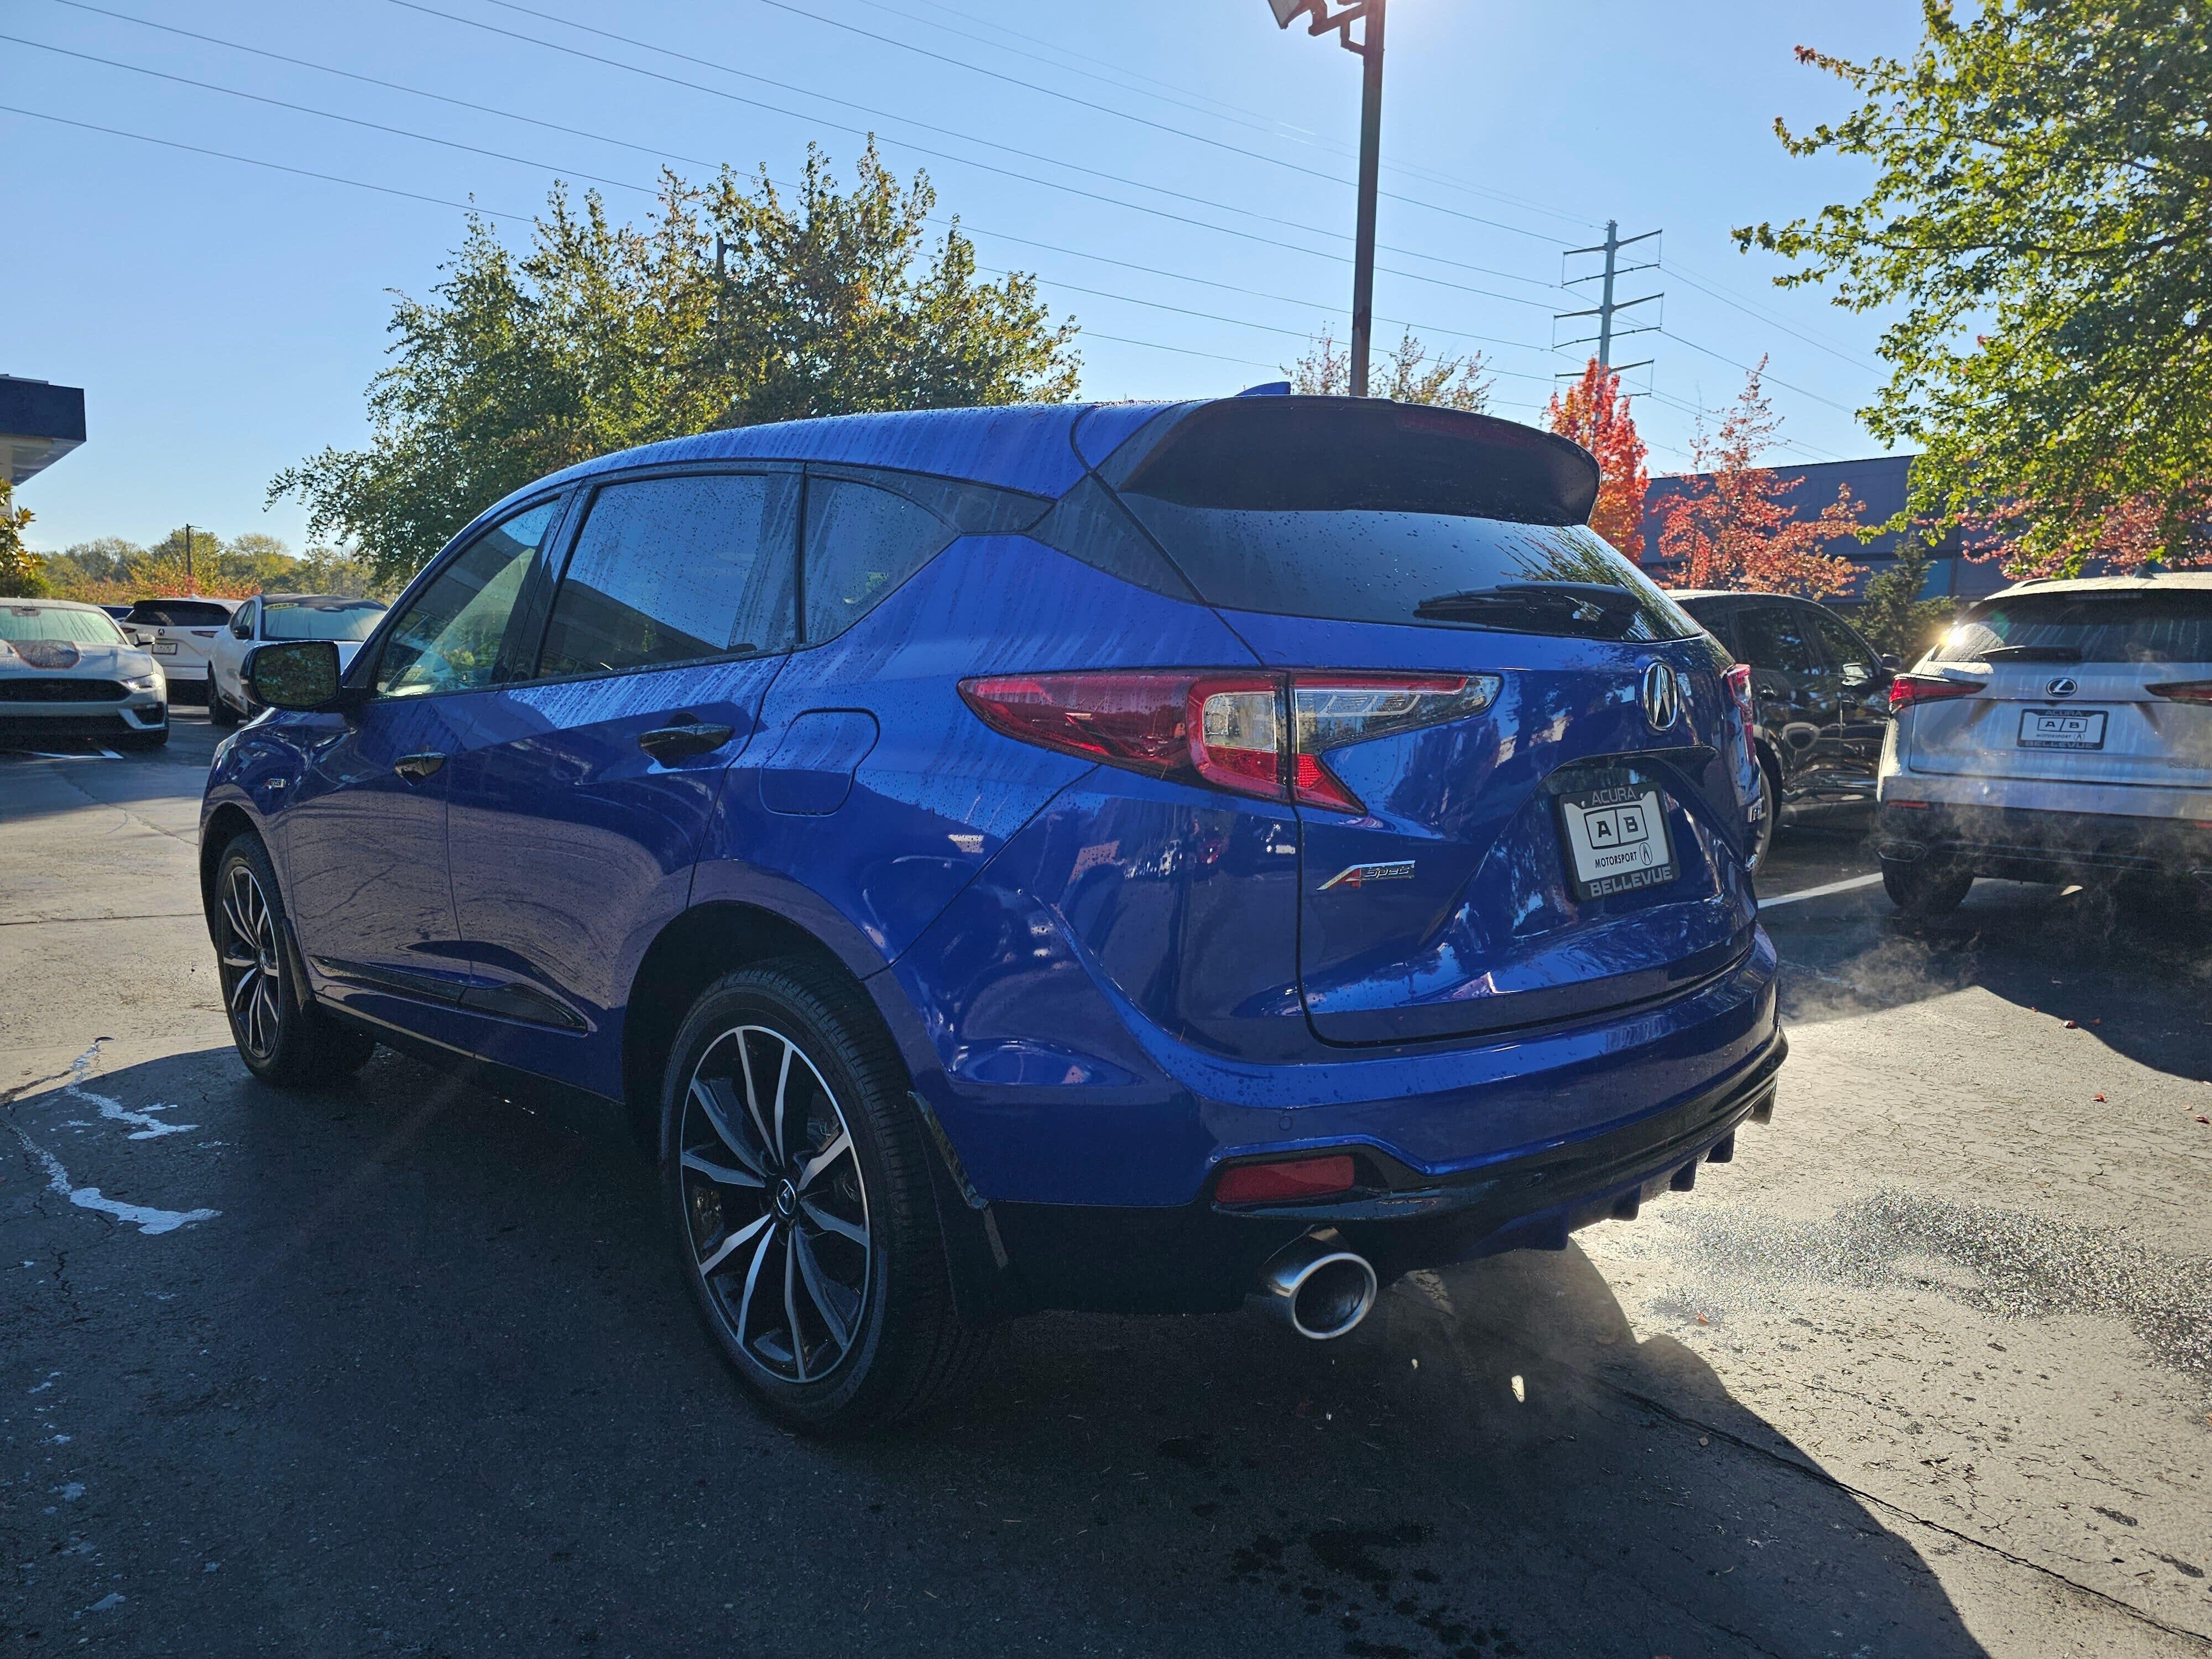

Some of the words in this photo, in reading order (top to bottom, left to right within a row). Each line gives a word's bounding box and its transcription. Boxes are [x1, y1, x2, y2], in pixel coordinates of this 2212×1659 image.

[2025, 740, 2094, 749] BELLEVUE
[1592, 787, 1637, 805] ACURA
[1596, 821, 1612, 838] A
[1624, 816, 1639, 833] B
[1595, 851, 1637, 869] MOTORSPORT
[1589, 866, 1673, 898] BELLEVUE
